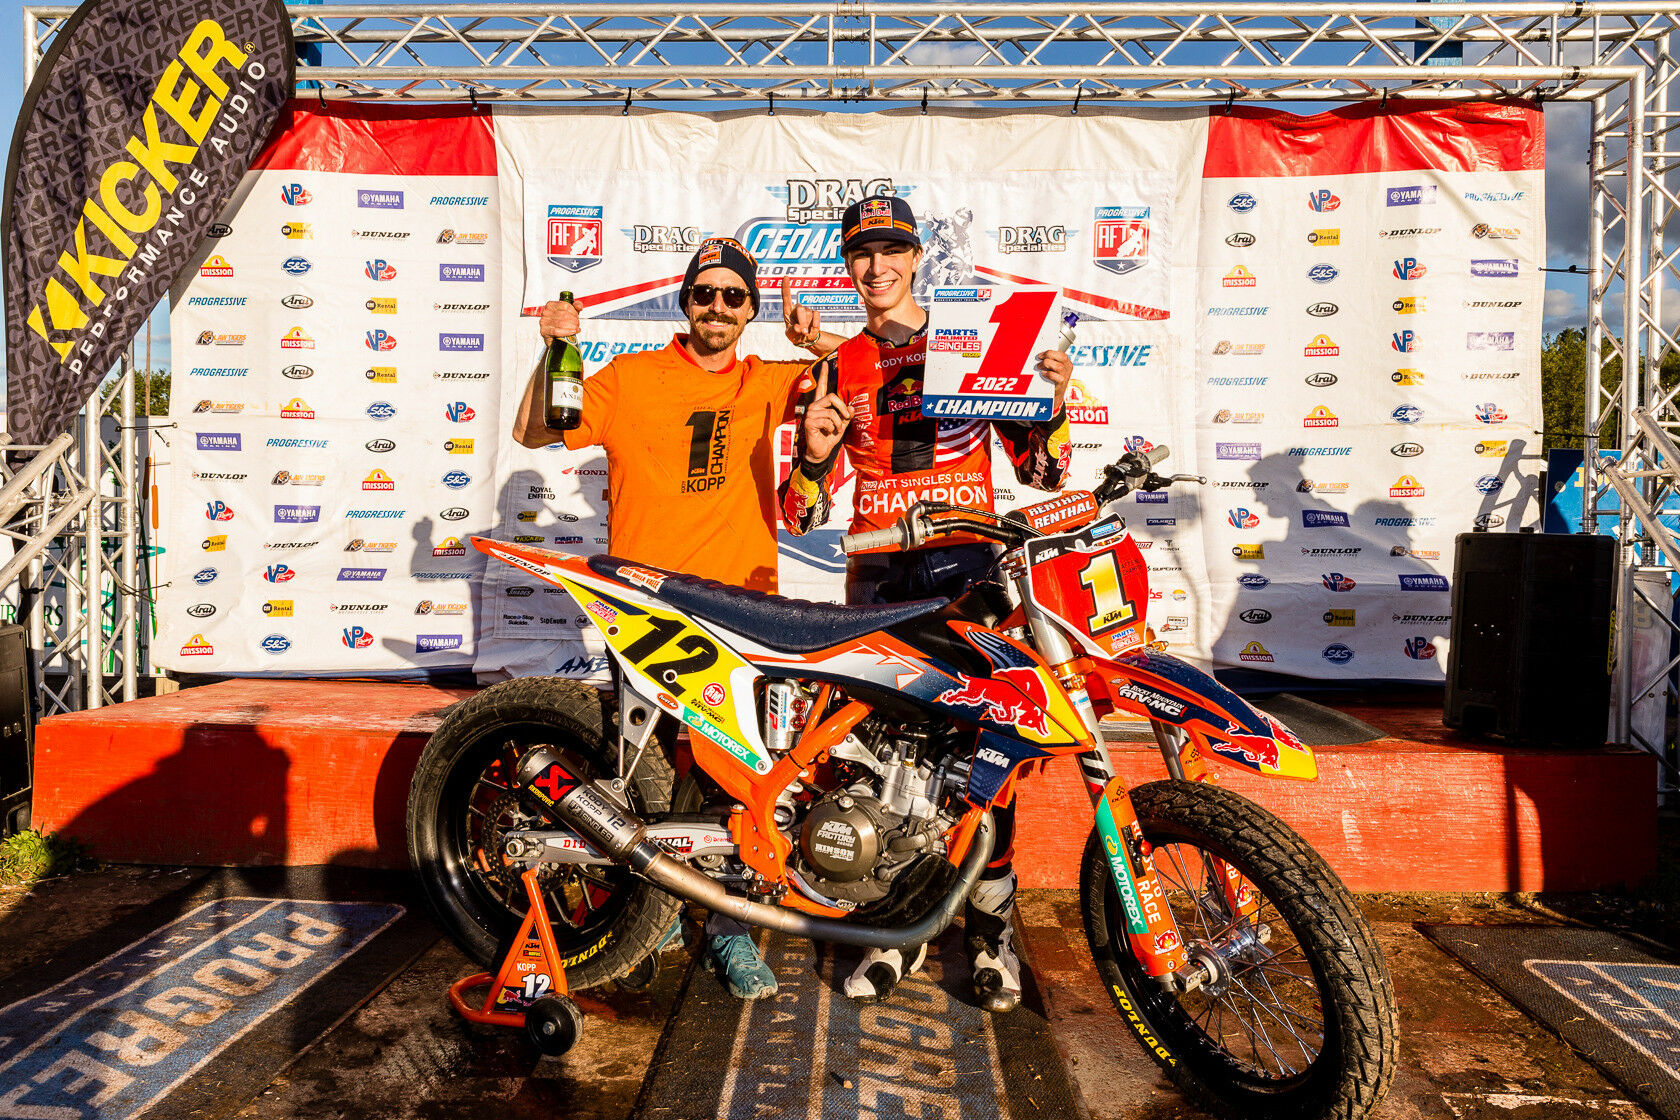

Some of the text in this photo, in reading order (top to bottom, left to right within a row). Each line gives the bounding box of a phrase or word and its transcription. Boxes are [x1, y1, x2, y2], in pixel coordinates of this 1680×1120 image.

[211, 61, 266, 155] AUDIO
[57, 19, 248, 307] KICKER
[281, 183, 302, 206] VP
[370, 194, 400, 204] YAMAHA
[787, 178, 897, 209] DRAG
[430, 196, 489, 206] PROGRESSIVE
[1230, 197, 1255, 208] S&S
[1310, 189, 1331, 212] VP
[550, 207, 600, 216] PROGRESSIVE
[861, 210, 875, 219] Red
[1097, 208, 1147, 218] PROGRESSIVE
[360, 230, 411, 239] DUNLOP
[552, 223, 581, 246] AFT
[634, 226, 701, 242] DRAG
[999, 227, 1066, 244] DRAG
[1098, 223, 1129, 249] AFT
[634, 242, 700, 253] Specialtie
[751, 228, 842, 260] CEDAR
[999, 242, 1066, 253] Specialties
[366, 259, 387, 281] VP
[758, 266, 813, 275] HORT
[825, 279, 845, 288] 24,
[935, 289, 977, 297] PROGRESSIVE
[188, 297, 247, 306] PROGRESSIVE
[285, 296, 310, 308] Arai
[801, 295, 856, 305] PROGRESSIVE
[1208, 307, 1270, 316] PROGRESSIVE
[1310, 304, 1336, 315] Arai
[214, 334, 246, 342] LAW TIGERS
[282, 339, 315, 349] MISSION
[959, 291, 1058, 395] 1
[938, 341, 980, 351] SINGLES
[1069, 345, 1152, 366] RESSIVE
[874, 357, 903, 370] KODY
[190, 368, 248, 377] PROGRESSIVE
[442, 372, 490, 380] DUNLOP
[971, 376, 1018, 391] 2022
[1208, 377, 1269, 386] PROGRESSIVE
[1309, 374, 1335, 385] Arai
[888, 396, 911, 412] Red
[934, 399, 1038, 417] CHAMPION
[369, 406, 394, 416] S&S
[1304, 418, 1338, 427] MISSION
[207, 436, 238, 445] YAMAHA
[267, 439, 329, 448] PROGRESSIVE
[370, 440, 393, 451] Arai
[685, 411, 716, 477] 1
[1289, 447, 1353, 456] PROGRESSIVE
[199, 473, 248, 481] DUNLOP
[574, 468, 608, 476] HOND
[363, 481, 394, 490] MISSION
[444, 474, 470, 485] S&S
[687, 476, 726, 493] KOPP
[878, 479, 898, 490] AFT
[901, 473, 952, 488] SINGLES
[954, 472, 984, 483] CLASS
[1221, 481, 1269, 489] DUNLOP
[530, 485, 552, 493] ROYAL
[1313, 482, 1349, 490] LAW TIGERS
[1390, 487, 1424, 497] MISSION
[859, 484, 988, 515] CHAMPION
[1027, 492, 1089, 517] RENTHAL
[286, 508, 316, 518] YAMAHA
[346, 510, 406, 519] PROGRESSIVE
[444, 509, 467, 519] Arai
[1034, 500, 1095, 529] RENTHAL
[1229, 508, 1249, 529] VP
[1315, 514, 1346, 523] YAMAHA
[272, 541, 319, 551] DUNLOP
[433, 546, 466, 556] MISSION
[1035, 547, 1059, 563] KTM
[507, 555, 551, 576] DUNLOP
[195, 570, 217, 582] S&S
[267, 564, 288, 583] VP
[352, 570, 381, 578] YAMAHA
[1412, 577, 1445, 586] YAMAHA
[1078, 549, 1138, 637] 1
[339, 604, 388, 612] DUNLOP
[432, 603, 449, 611] LAW
[595, 600, 619, 616] PARTS
[1103, 610, 1122, 624] KTM
[1244, 611, 1268, 622] Arai
[343, 626, 364, 649] VP
[1112, 627, 1135, 639] PARTS
[428, 637, 459, 647] YAMAHA
[1405, 636, 1426, 659] VP
[181, 646, 213, 655] MISSION
[620, 615, 719, 697] 12
[1326, 648, 1351, 660] S&S
[1240, 653, 1274, 663] MISSION
[706, 687, 723, 703] RM
[1131, 685, 1186, 709] ROCKY MOUNTAIN
[769, 688, 779, 731] WP
[701, 722, 751, 761] MOTOREX
[976, 747, 1010, 769] KTM
[582, 789, 609, 810] KODY
[576, 794, 627, 831] KOPP 12
[580, 812, 613, 842] SINGLES
[821, 820, 853, 836] KTM
[817, 830, 857, 844] FACTORY
[1111, 856, 1143, 927] MOTOREX
[1150, 876, 1162, 898] TO
[1137, 879, 1162, 924] RACE
[561, 935, 608, 969] DUNLO
[517, 963, 537, 972] KOPP
[523, 973, 551, 998] 12
[1113, 984, 1171, 1060] DUNLOP
